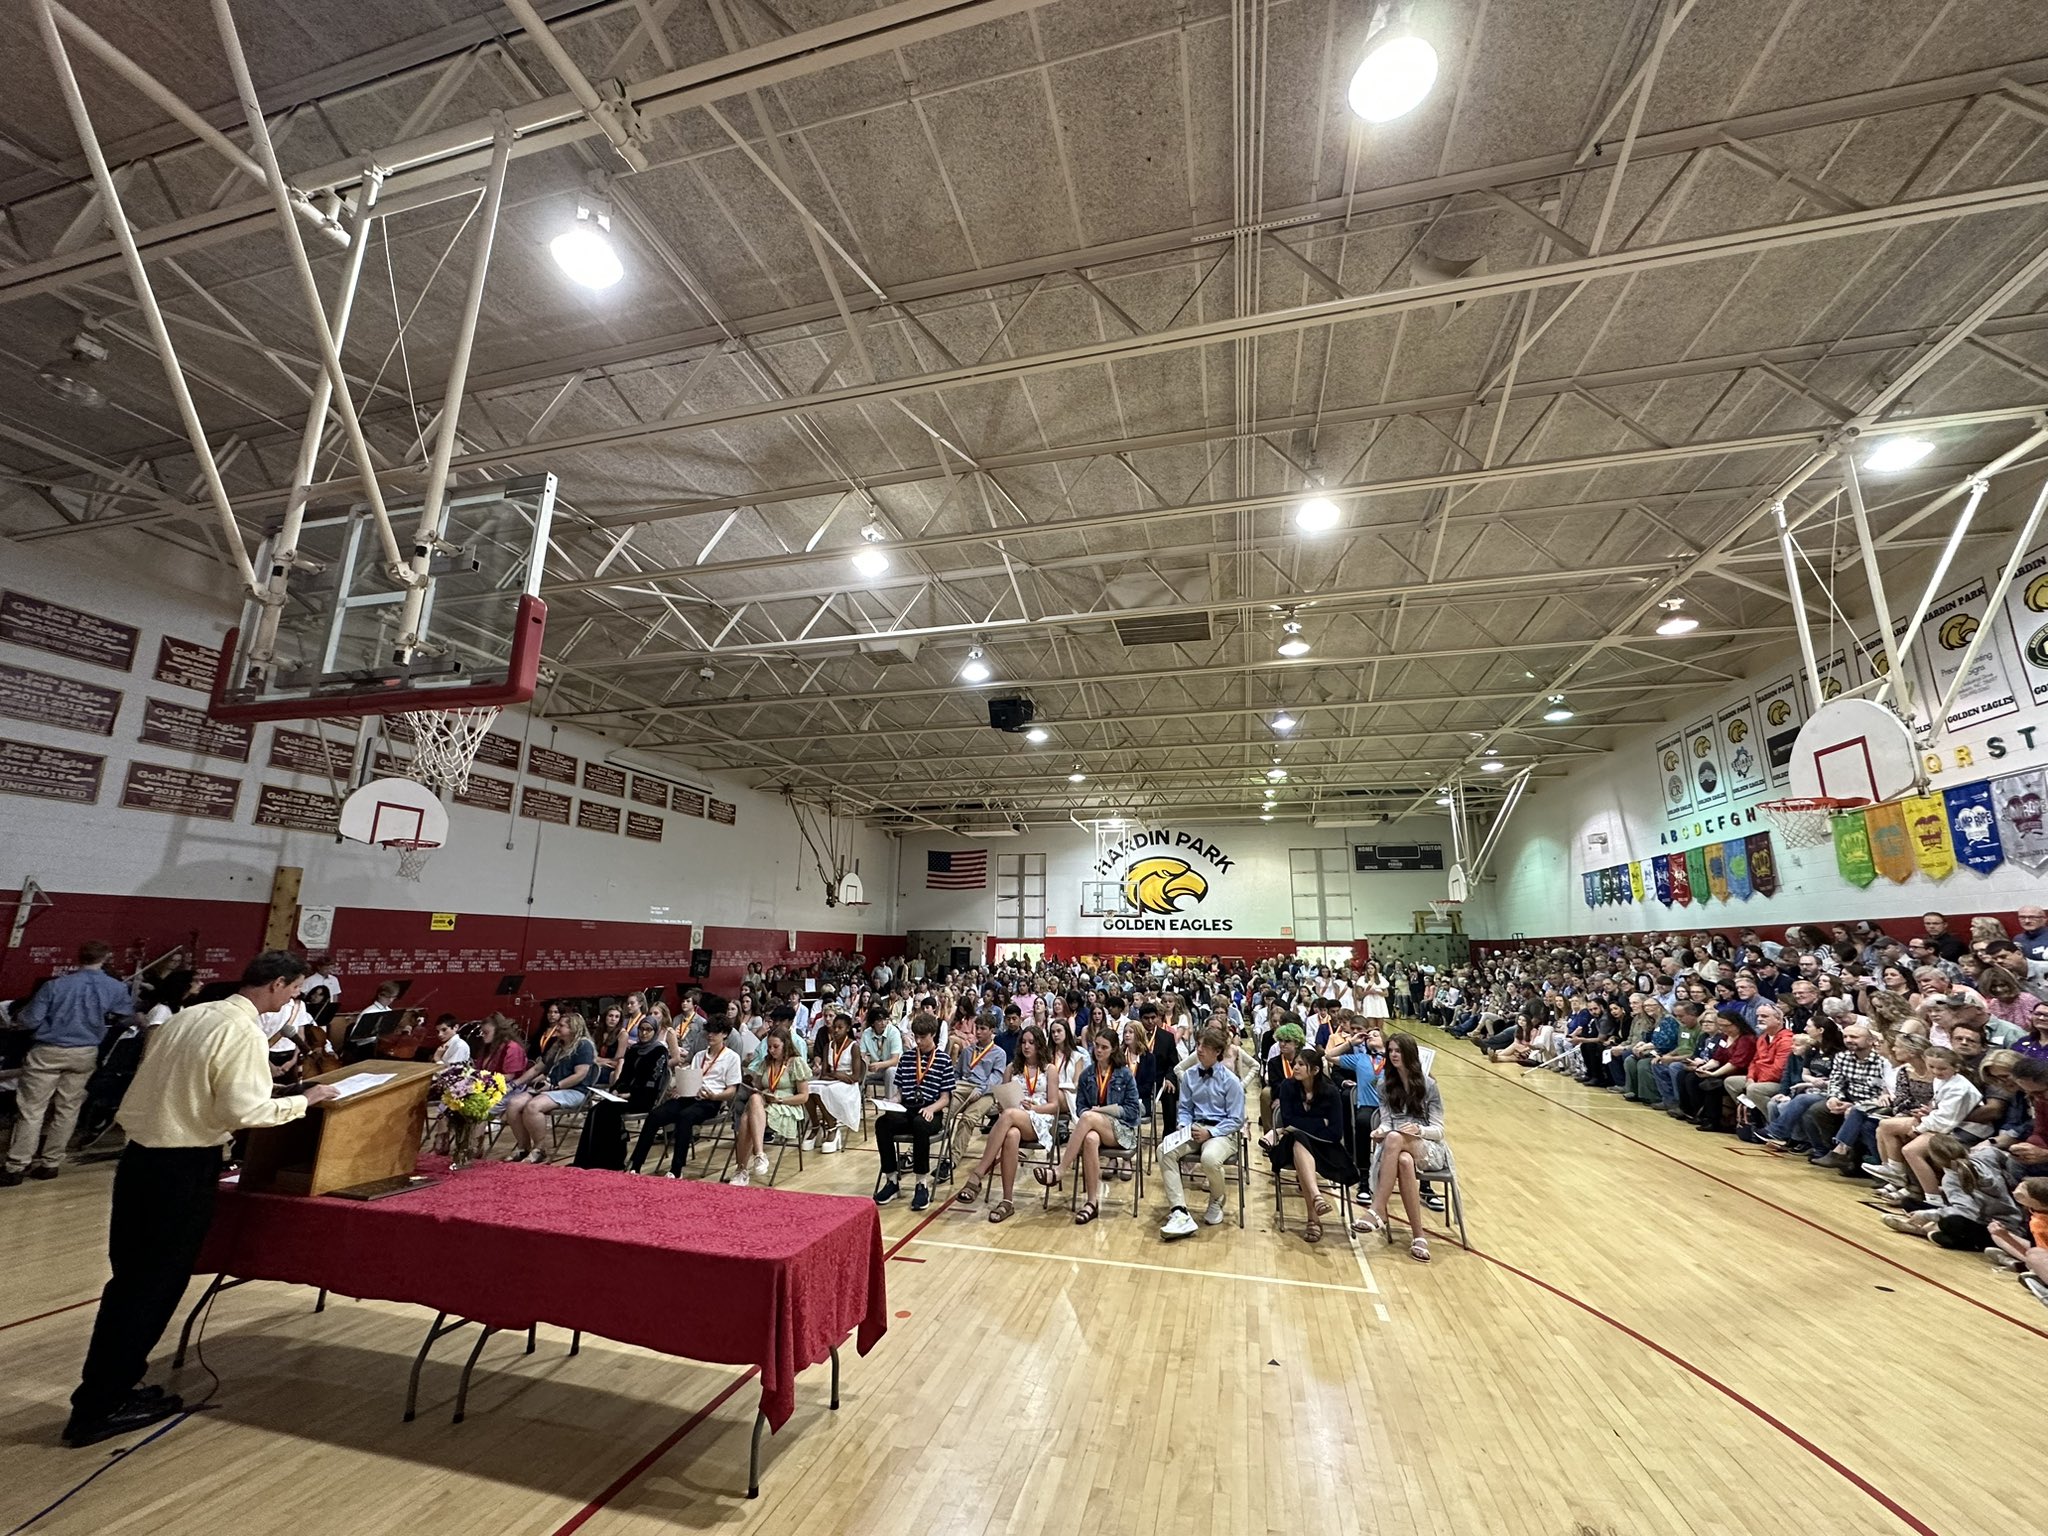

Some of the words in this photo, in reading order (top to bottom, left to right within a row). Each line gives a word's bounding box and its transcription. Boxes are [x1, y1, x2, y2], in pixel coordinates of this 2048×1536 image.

[2011, 556, 2047, 580] ARDIN
[1922, 600, 1957, 624] HARDIN
[1957, 586, 1986, 606] PARK
[12, 602, 72, 625] Golden
[78, 620, 128, 640] Eagles
[0, 673, 53, 691] olden
[58, 686, 111, 703] Eagles
[1778, 681, 1795, 694] PARK
[12, 691, 83, 711] 2011-2012
[1947, 705, 1979, 723] GOLDEN
[1981, 695, 2014, 713] EAGLES
[154, 708, 203, 724] Golden
[206, 718, 246, 734] Eagles
[1915, 723, 1932, 734] GLES
[280, 735, 318, 749] Golden
[1954, 745, 1974, 768] R
[1986, 736, 2007, 759] S
[2017, 726, 2036, 750] T
[0, 749, 33, 761] den
[39, 754, 93, 770] Eagles
[0, 764, 66, 780] 014-2015
[137, 770, 187, 785] Golden
[190, 778, 233, 792] Eagles
[267, 792, 306, 804] Golden
[1661, 833, 1668, 845] A
[1670, 830, 1678, 842] B
[1682, 826, 1689, 839] C
[1694, 822, 1702, 836] D
[1705, 819, 1714, 833] E
[1717, 816, 1725, 830] F
[1730, 812, 1741, 826] G
[1745, 807, 1756, 822] H
[1094, 830, 1170, 876] HARDIN
[1175, 831, 1236, 875] PARK
[1103, 919, 1165, 931] GOLDEN
[1170, 919, 1233, 931] EAGLES
